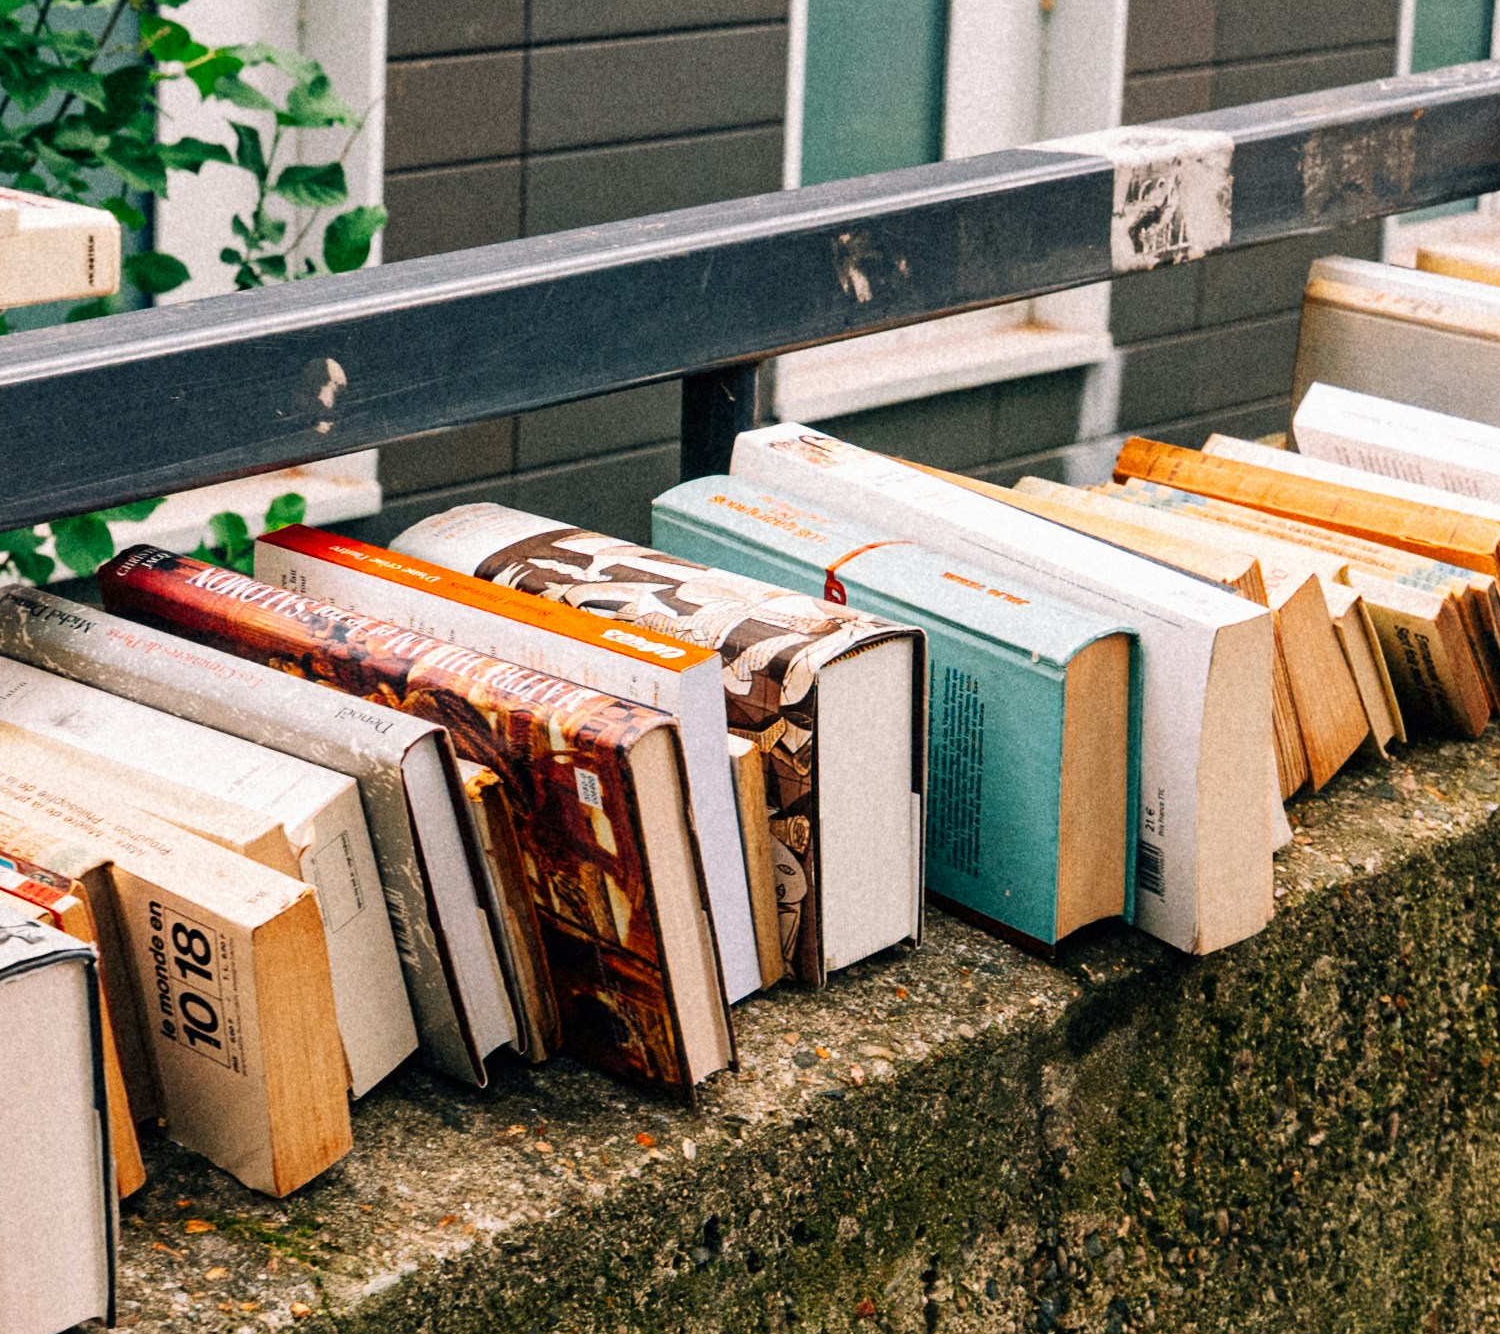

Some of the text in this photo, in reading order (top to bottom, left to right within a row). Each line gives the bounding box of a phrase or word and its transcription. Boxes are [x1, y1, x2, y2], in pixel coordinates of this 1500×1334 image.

[186, 565, 308, 619] SALOMON
[42, 605, 98, 635] Michel
[386, 632, 480, 681] HIRAM
[334, 705, 396, 736] Denoël
[112, 822, 173, 858] Proudhon
[1144, 806, 1155, 833] 21 €
[148, 900, 178, 1042] le monde en
[171, 921, 223, 1051] 10 18
